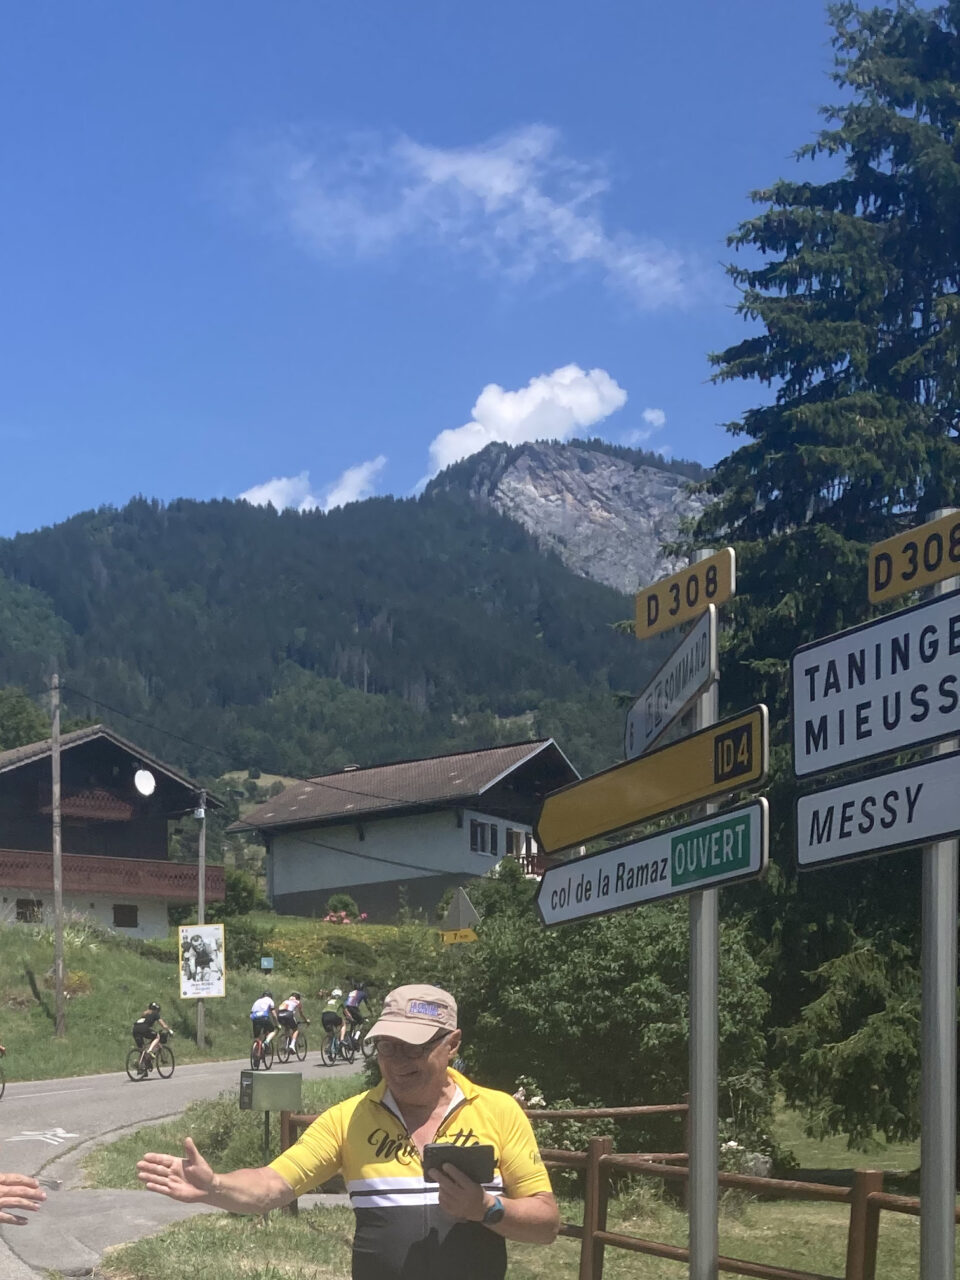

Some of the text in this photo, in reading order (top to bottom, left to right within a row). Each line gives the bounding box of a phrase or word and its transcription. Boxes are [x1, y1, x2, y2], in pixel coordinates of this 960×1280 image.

[647, 564, 718, 626] D 308
[874, 522, 960, 593] D 308
[804, 614, 960, 702] TANINGE
[805, 674, 959, 756] MIEUSS
[809, 783, 924, 846] MESSY
[551, 824, 746, 910] col de la Ramaz OUVERT
